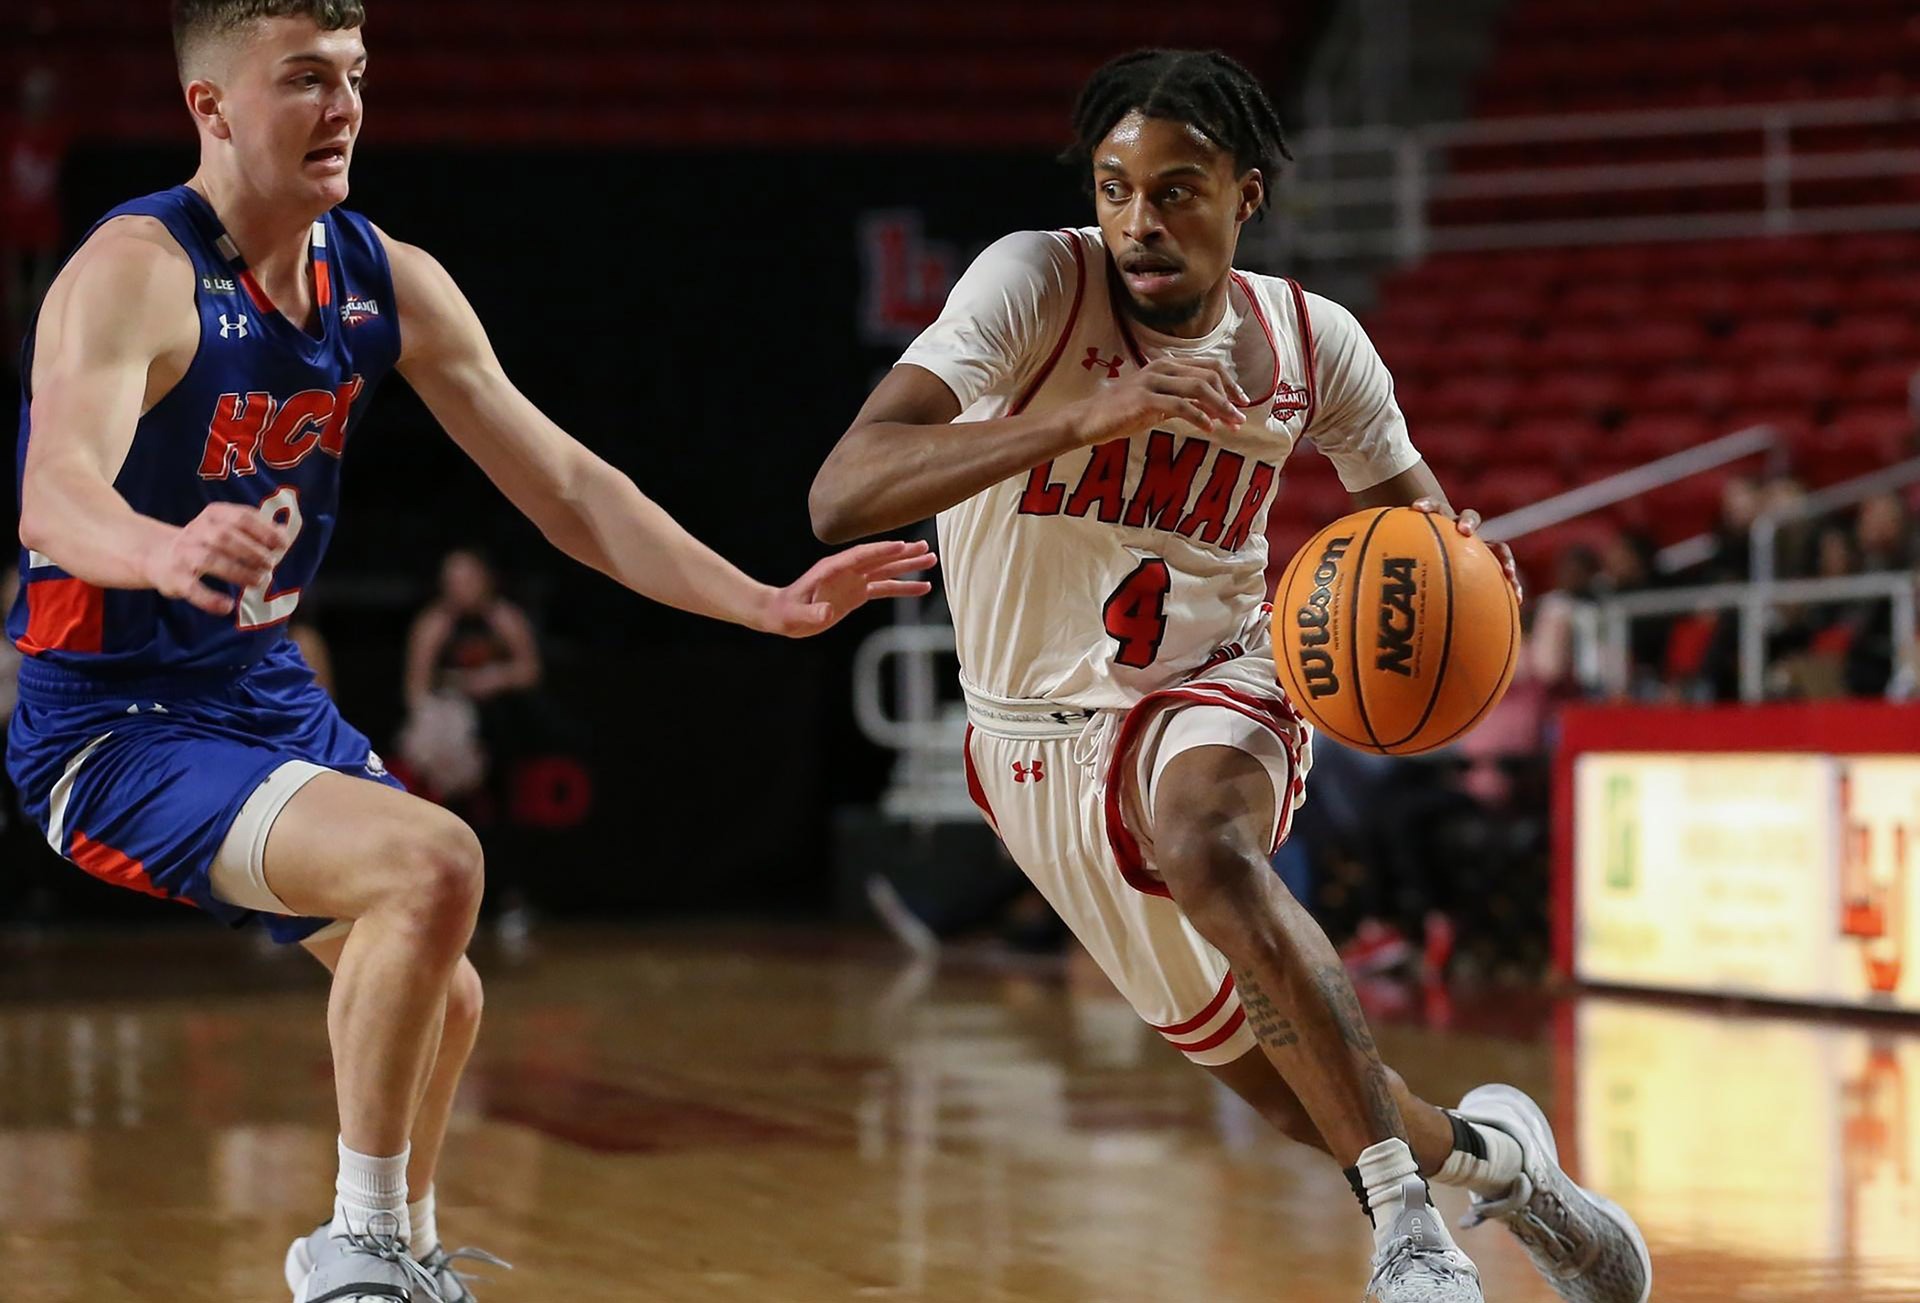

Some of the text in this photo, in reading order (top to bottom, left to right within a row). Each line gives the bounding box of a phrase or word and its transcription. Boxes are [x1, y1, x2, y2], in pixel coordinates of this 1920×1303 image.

[202, 278, 236, 291] D LEE
[1017, 429, 1276, 553] LAMAR
[236, 484, 303, 631] 2
[1102, 557, 1171, 670] 4
[1297, 537, 1355, 700] Wilson
[1375, 557, 1417, 678] NCAA
